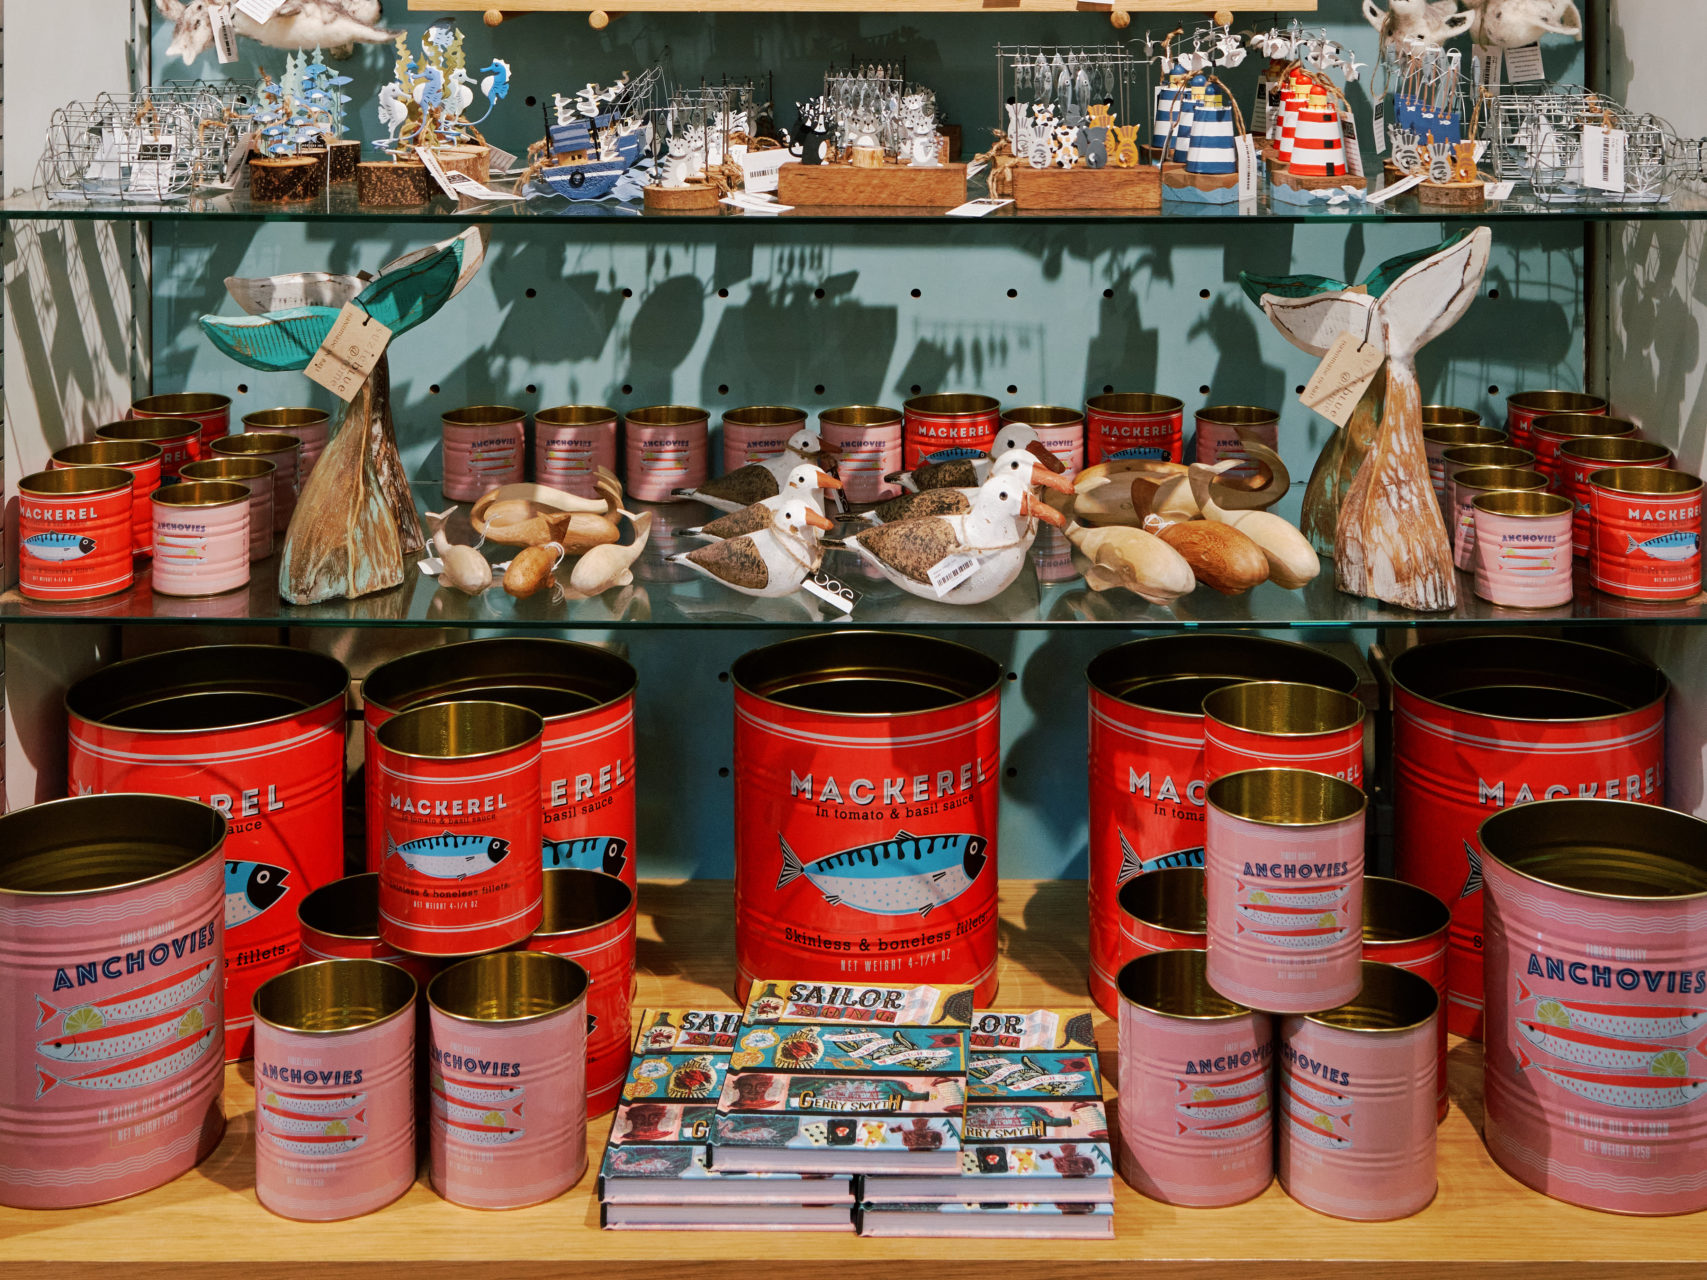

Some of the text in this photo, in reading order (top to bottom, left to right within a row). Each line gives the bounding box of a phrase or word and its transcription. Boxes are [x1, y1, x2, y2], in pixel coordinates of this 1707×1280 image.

[918, 424, 990, 439] MACKEREL
[1101, 423, 1174, 437] MACKEREL
[471, 437, 516, 449] ANCHOVIES
[545, 438, 592, 448] ANCHOVIES
[642, 439, 689, 448] ANCHOVIES
[747, 440, 785, 449] ANCHOV
[840, 440, 886, 448] ANCHOVIES
[1040, 439, 1074, 447] CHOVIES
[20, 505, 98, 521] MACKEREL
[1628, 504, 1701, 521] MACKERE
[157, 522, 206, 533] ANCHOVIES
[1502, 534, 1557, 543] ANCHOVIES
[790, 757, 987, 806] MACKEREL
[390, 792, 508, 816] MACKEREL
[543, 795, 614, 825] basil sauce
[816, 793, 974, 821] In tomato & basil sauce
[1153, 802, 1205, 822] In toma
[448, 816, 470, 825] basil
[1243, 861, 1349, 879] ANCHOVIES
[425, 902, 447, 910] WEIGHT
[449, 902, 468, 910] 4-1/4
[784, 911, 989, 952] Skinless & boneless fillets.
[52, 921, 216, 993] ANCHOVIES
[236, 942, 291, 968] fillets.
[840, 948, 951, 972] NET WEIGHT 4-1/4 OZ
[1586, 944, 1647, 961] FINEST QUALITY
[1527, 954, 1706, 994] ANCHOVIES
[787, 984, 904, 1010] SAILOR
[796, 1005, 895, 1023] SONG
[1185, 1043, 1273, 1075] ANCHOVIE
[262, 1062, 363, 1085] ANCHOVIES
[98, 1110, 109, 1124] IN
[113, 1102, 139, 1122] OLIVE
[142, 1098, 157, 1113] OIL
[167, 1080, 192, 1104] LEMON
[798, 1090, 904, 1112] GERRY SMYTH
[117, 1127, 131, 1142] NET
[134, 1119, 162, 1138] WEIGHT
[996, 1120, 1048, 1139] SMYTH
[1565, 1110, 1575, 1126] IN
[1578, 1113, 1604, 1133] OLIVE
[1609, 1120, 1624, 1135] OIL
[1638, 1122, 1670, 1137] LEMON
[1584, 1139, 1599, 1152] NET
[1601, 1142, 1630, 1158] WEIGHT
